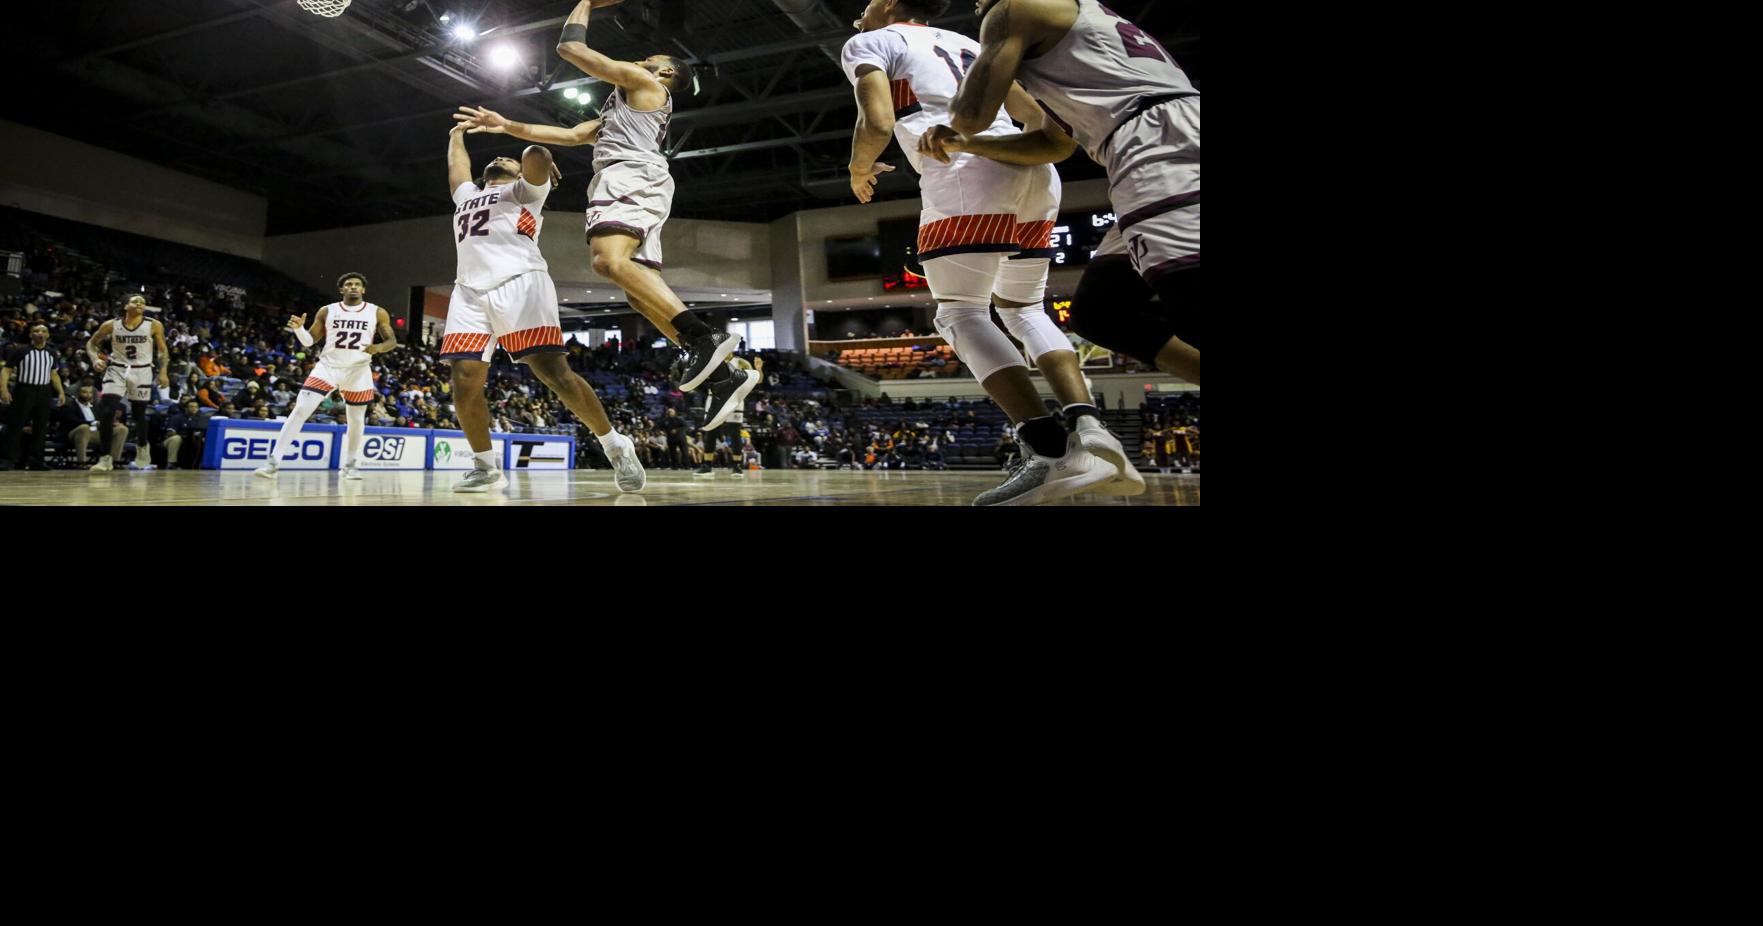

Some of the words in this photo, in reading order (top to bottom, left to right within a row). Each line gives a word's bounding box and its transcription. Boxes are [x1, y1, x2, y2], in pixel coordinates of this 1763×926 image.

[455, 193, 500, 215] STATE
[458, 209, 490, 243] 32
[1050, 233, 1072, 248] 21
[1055, 252, 1066, 264] 2
[332, 319, 369, 331] STATE
[115, 335, 148, 344] PANTHERS
[335, 331, 362, 350] 22
[125, 345, 138, 360] 2
[363, 436, 406, 460] esi
